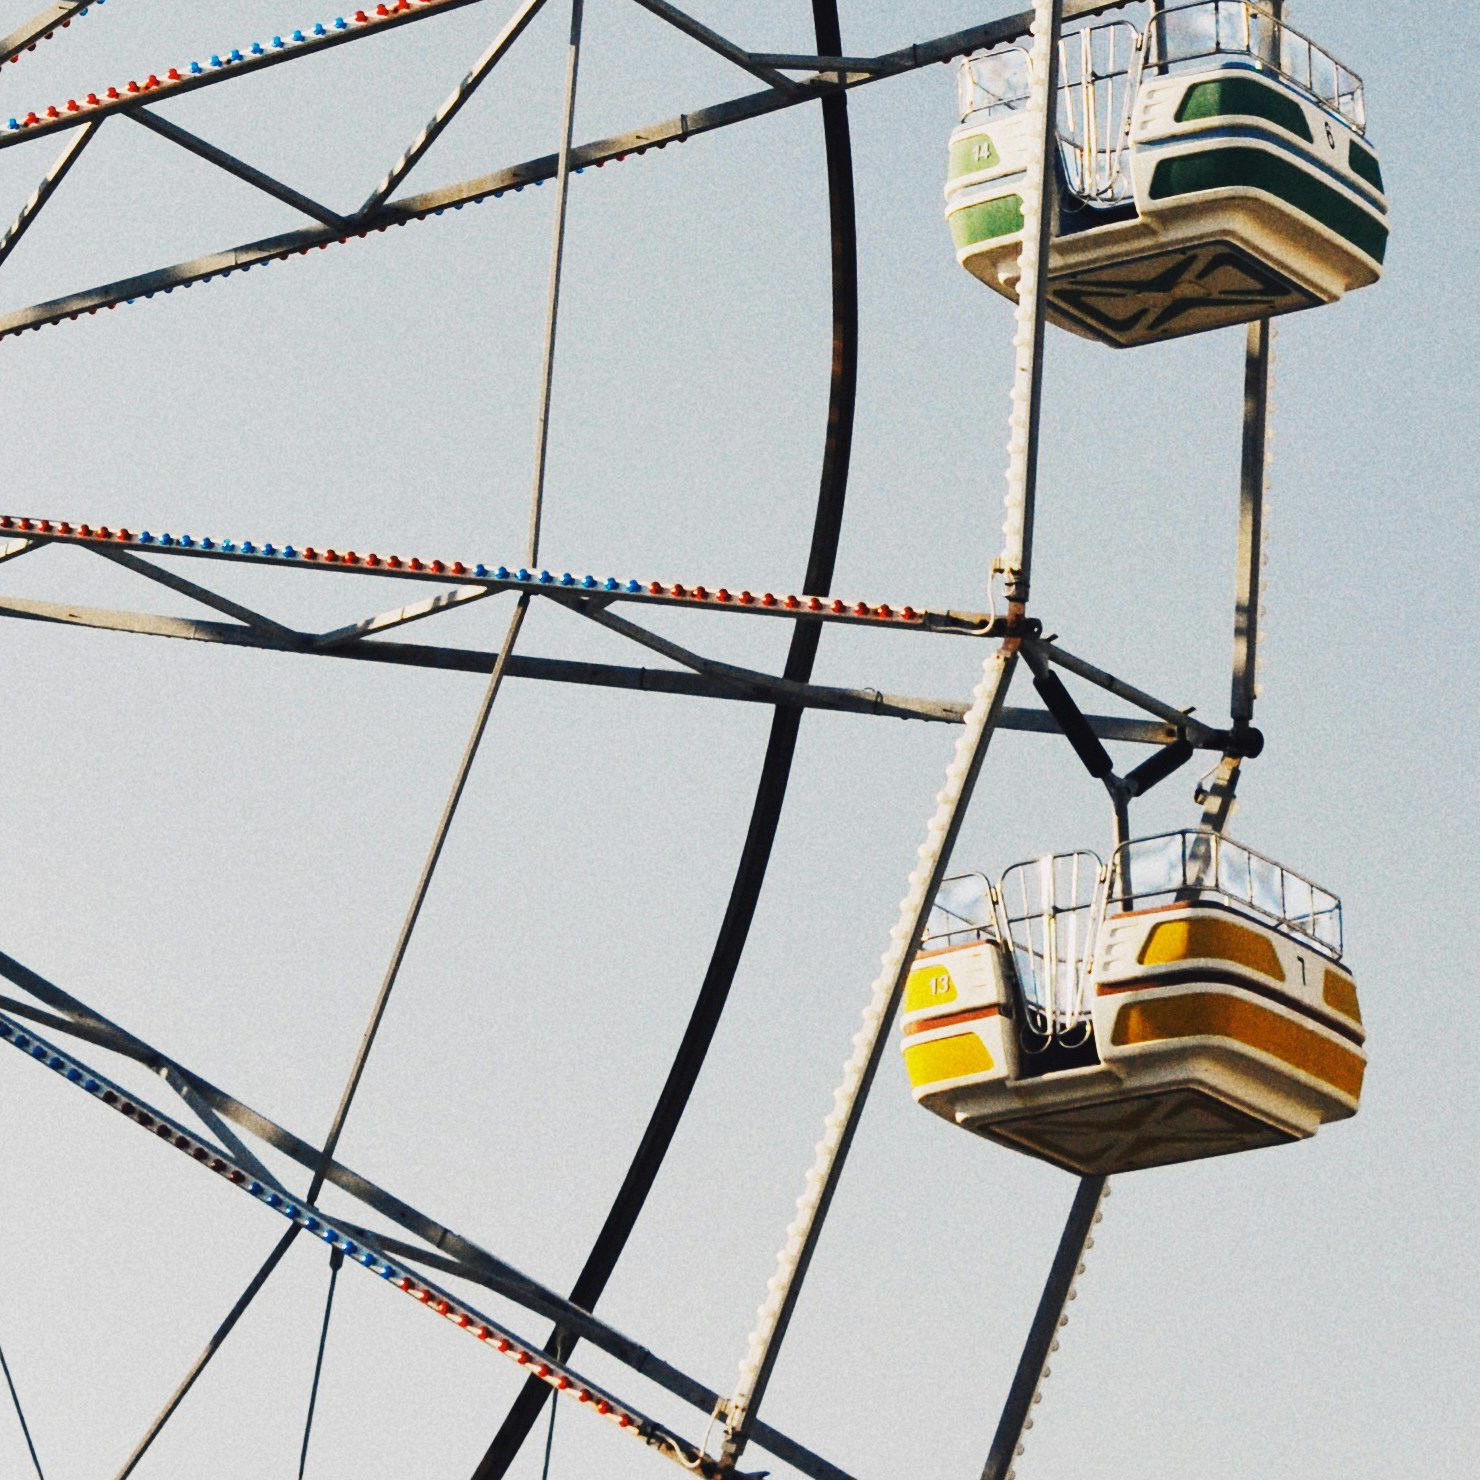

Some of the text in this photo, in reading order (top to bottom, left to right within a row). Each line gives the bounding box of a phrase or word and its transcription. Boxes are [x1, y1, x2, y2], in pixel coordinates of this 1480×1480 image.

[1324, 120, 1335, 150] 6
[972, 142, 992, 162] 14
[928, 974, 950, 995] 13
